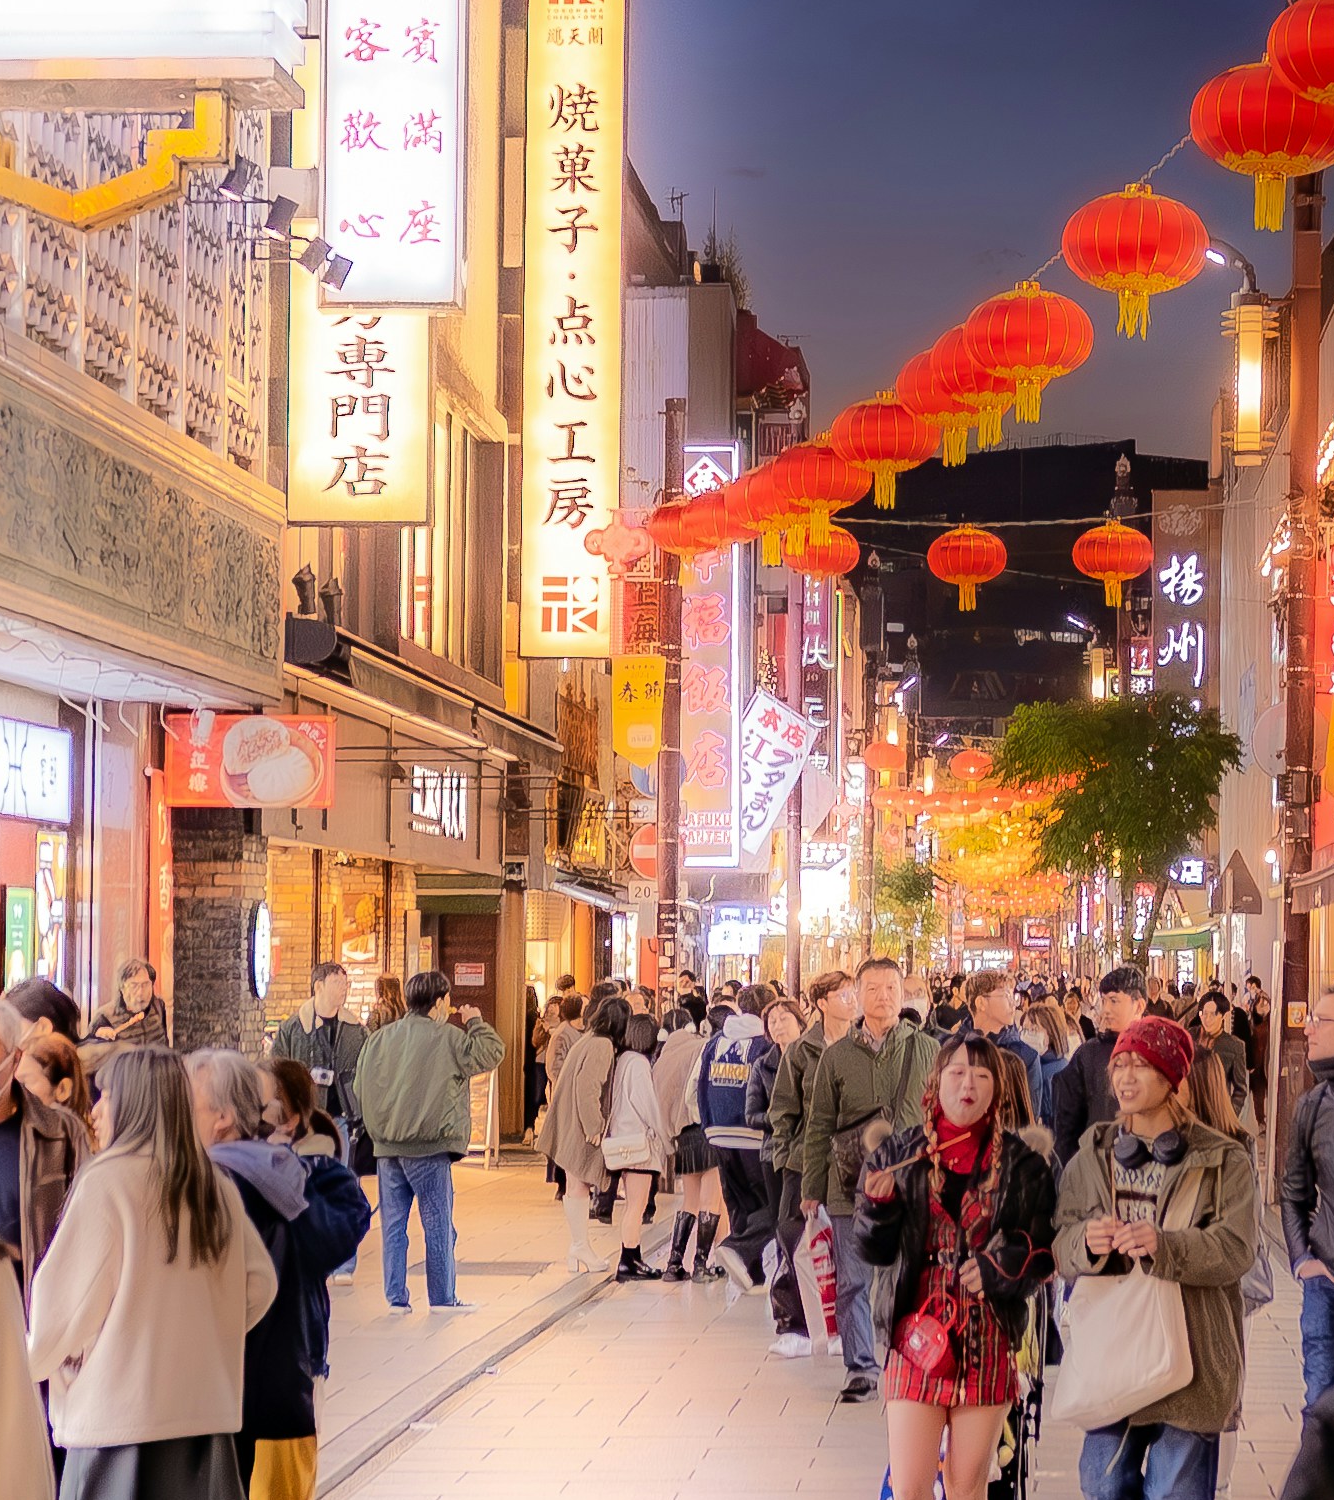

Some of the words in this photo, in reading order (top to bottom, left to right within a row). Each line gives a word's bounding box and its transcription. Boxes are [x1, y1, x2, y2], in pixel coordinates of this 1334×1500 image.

[543, 82, 601, 530] 焼菓子・点心工房
[187, 738, 211, 793] 正樓
